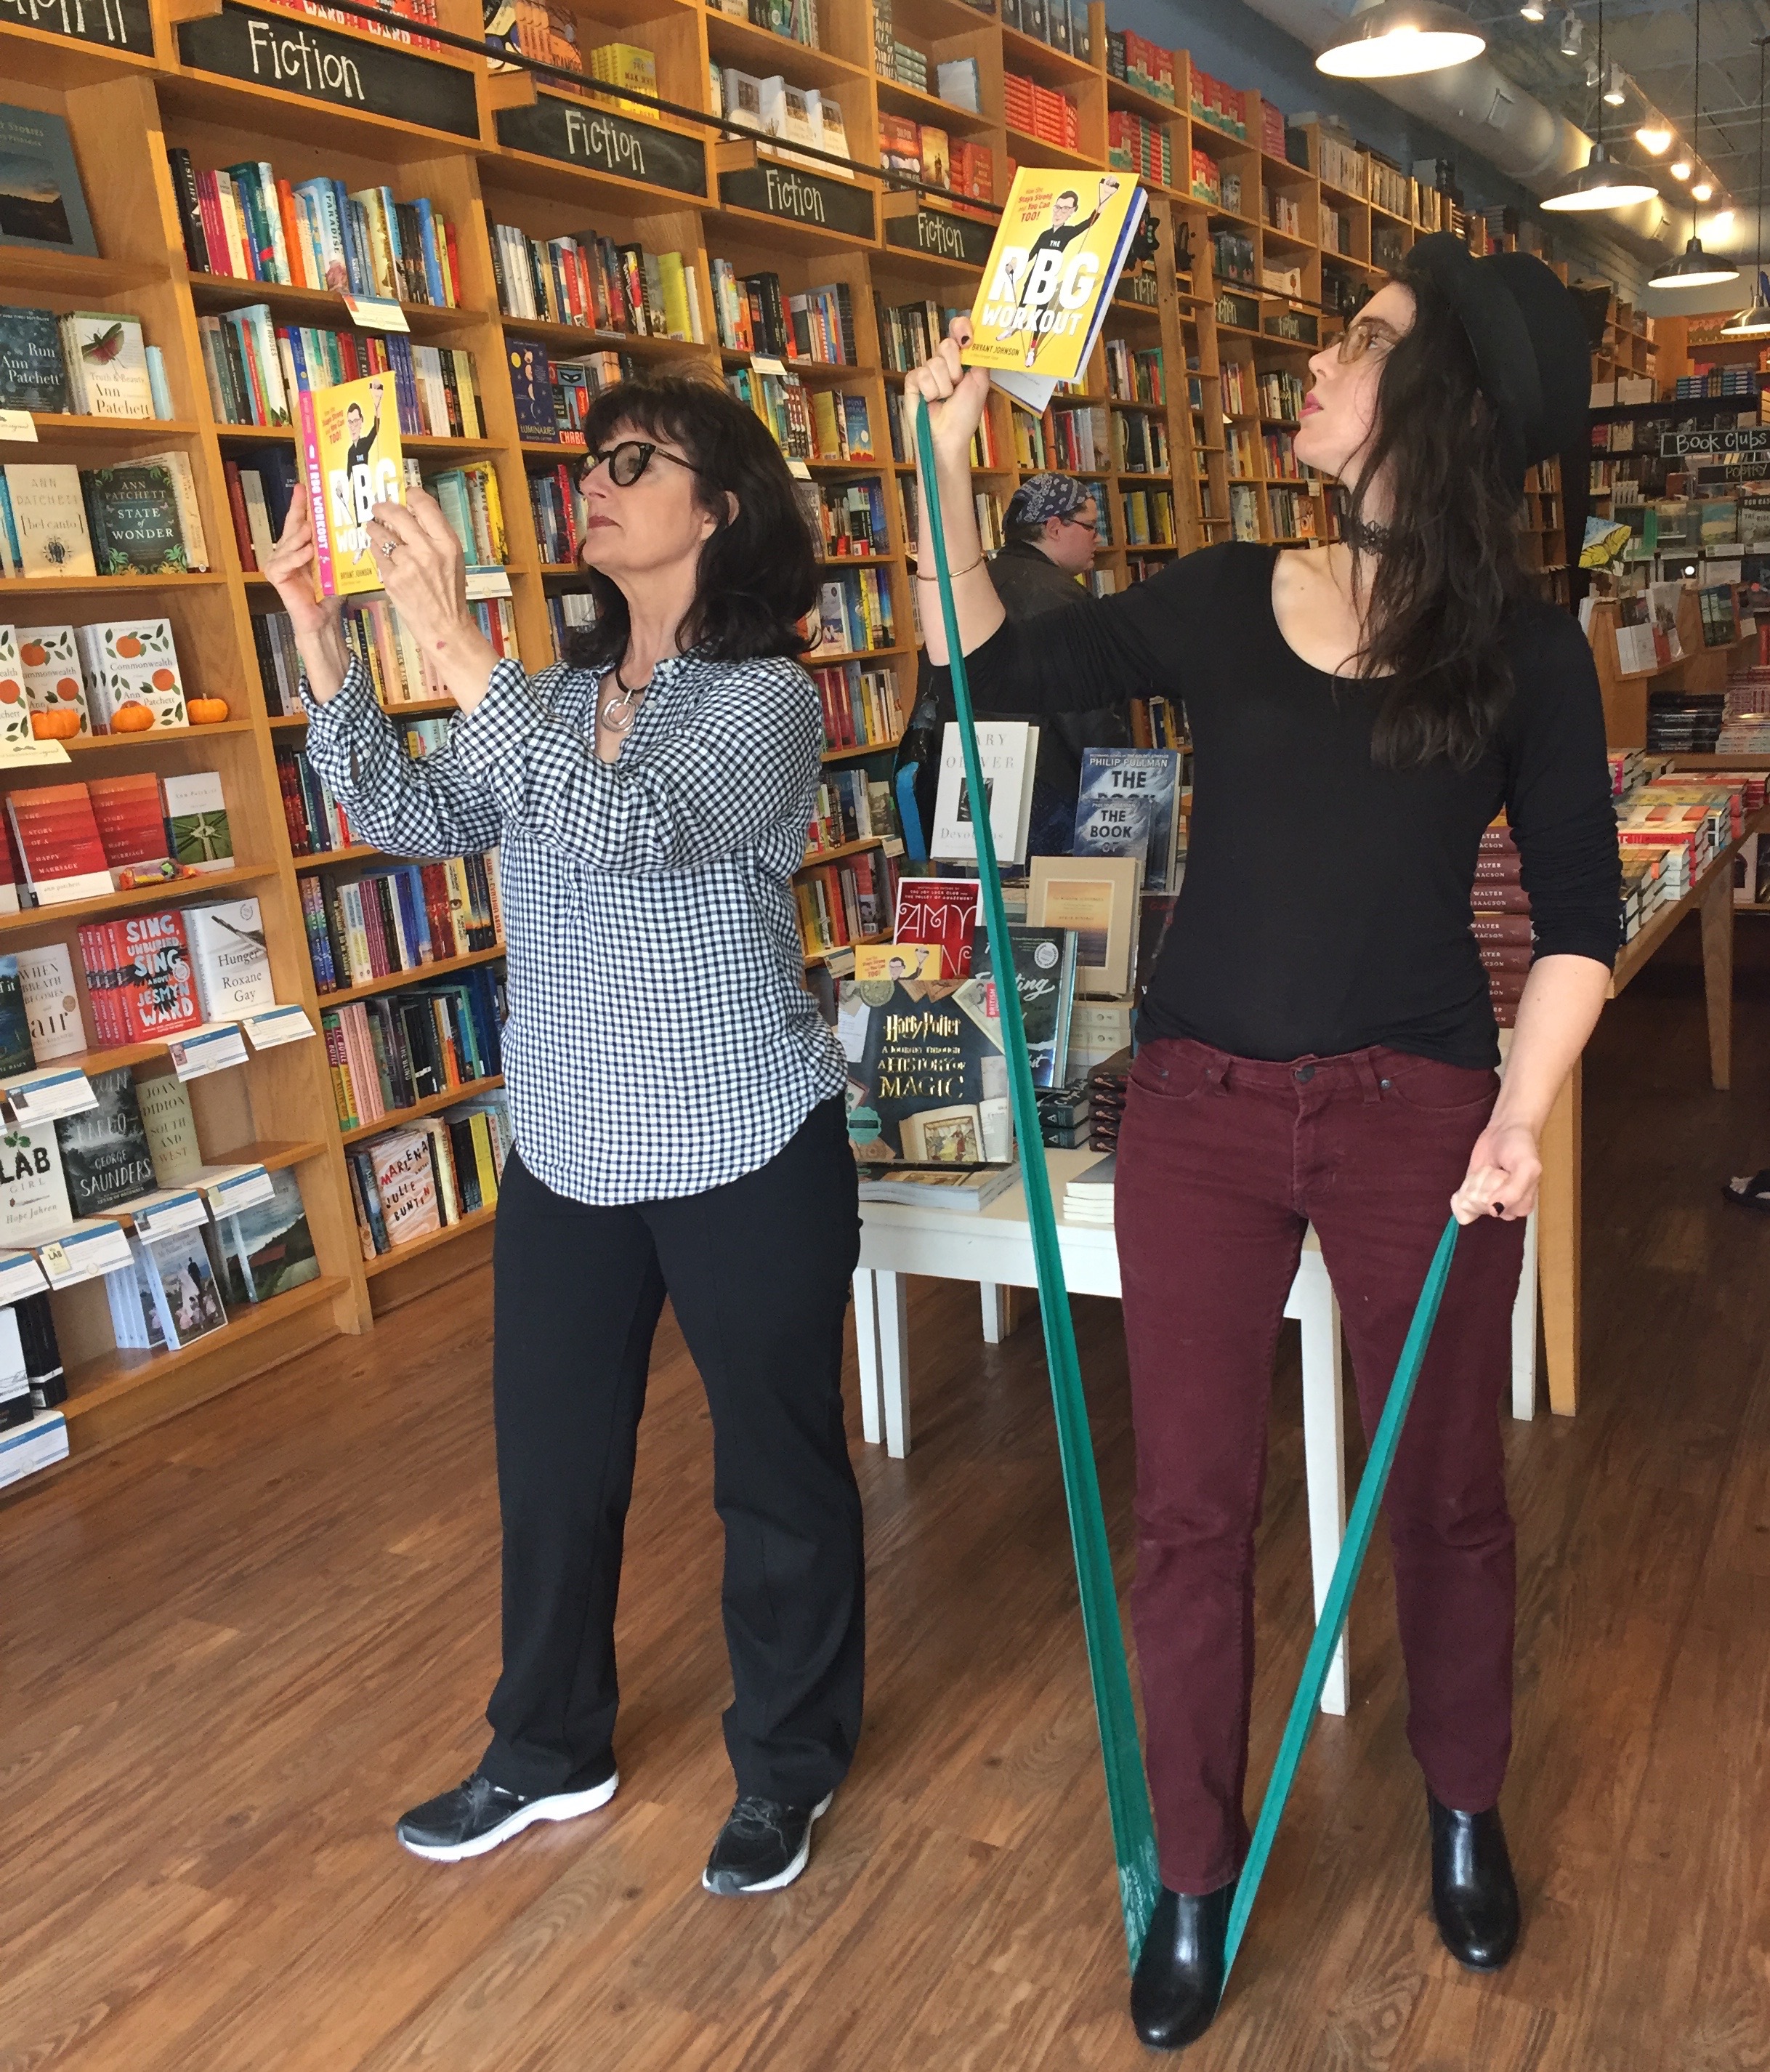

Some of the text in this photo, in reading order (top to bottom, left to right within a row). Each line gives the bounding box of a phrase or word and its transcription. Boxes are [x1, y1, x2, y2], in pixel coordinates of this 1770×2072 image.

[248, 20, 364, 100] Fiction
[565, 110, 644, 175] Fiction
[766, 169, 825, 222] Fiction
[1035, 193, 1053, 201] Strong
[326, 195, 340, 254] PARADISE
[1021, 211, 1040, 222] TOO!
[918, 212, 964, 258] Fiction
[988, 246, 1100, 310] RBG
[1133, 273, 1157, 305] Fictio
[1215, 295, 1237, 324] iction
[981, 304, 1084, 336] WORKOUT
[28, 342, 55, 358] Run
[267, 329, 278, 356] HOUSES
[971, 343, 1019, 356] BRYANT JOHNSON
[1, 355, 28, 369] Ann
[9, 370, 61, 385] Patchett
[96, 383, 120, 398] Ann
[97, 400, 149, 416] Patchett
[520, 425, 556, 435] LUMINARIES
[559, 430, 586, 445] CHABO
[1676, 430, 1767, 454] Book Clubs
[121, 481, 145, 491] ANN
[328, 457, 399, 527] RBG
[105, 491, 166, 501] PATCHETT
[117, 507, 161, 519] STATE
[137, 520, 145, 528] of
[312, 496, 328, 549] WORKOUT
[112, 528, 174, 540] WONDER
[110, 658, 173, 671] Commonwealth
[124, 691, 140, 700] Ann
[144, 697, 175, 706] Patchett
[29, 701, 46, 709] Ann
[946, 756, 1014, 768] OLVER
[1112, 770, 1147, 789] THE
[1102, 810, 1126, 823] THE
[28, 827, 52, 836] STORY
[1091, 826, 1132, 838] BOOK
[39, 863, 78, 874] MARRIAGE
[126, 915, 180, 943] SING,
[897, 903, 977, 940] AMY
[126, 937, 182, 956] UNBURIED,
[134, 949, 180, 977] SING
[218, 949, 262, 967] Hunger
[18, 963, 59, 980] WHEN
[222, 972, 262, 989] Roxane
[22, 976, 62, 992] BREATH
[24, 990, 64, 1004] BECOMES
[137, 982, 190, 1007] JESMYN
[234, 989, 256, 1003] Gay
[140, 998, 193, 1027] WARD
[31, 1012, 68, 1039] air
[883, 1011, 961, 1043] Harry Potter
[403, 1060, 412, 1081] BLIND
[878, 1060, 886, 1069] A
[887, 1057, 955, 1073] HISTORY
[146, 1081, 176, 1099] JOAN
[878, 1076, 963, 1099] MAGIC
[144, 1096, 185, 1116] DIDION
[150, 1117, 187, 1137] SOUTH
[161, 1134, 182, 1148] AND
[94, 1148, 127, 1170] GEORGE
[158, 1147, 188, 1163] WEST
[381, 1140, 429, 1186] MARLENA
[0, 1147, 51, 1186] LAB
[9, 1179, 47, 1194] GIRL
[80, 1158, 152, 1198] SAUNDERS
[386, 1181, 416, 1209] JULIE
[394, 1186, 430, 1222] BUNTIN
[6, 1204, 57, 1225] Hope Jahren
